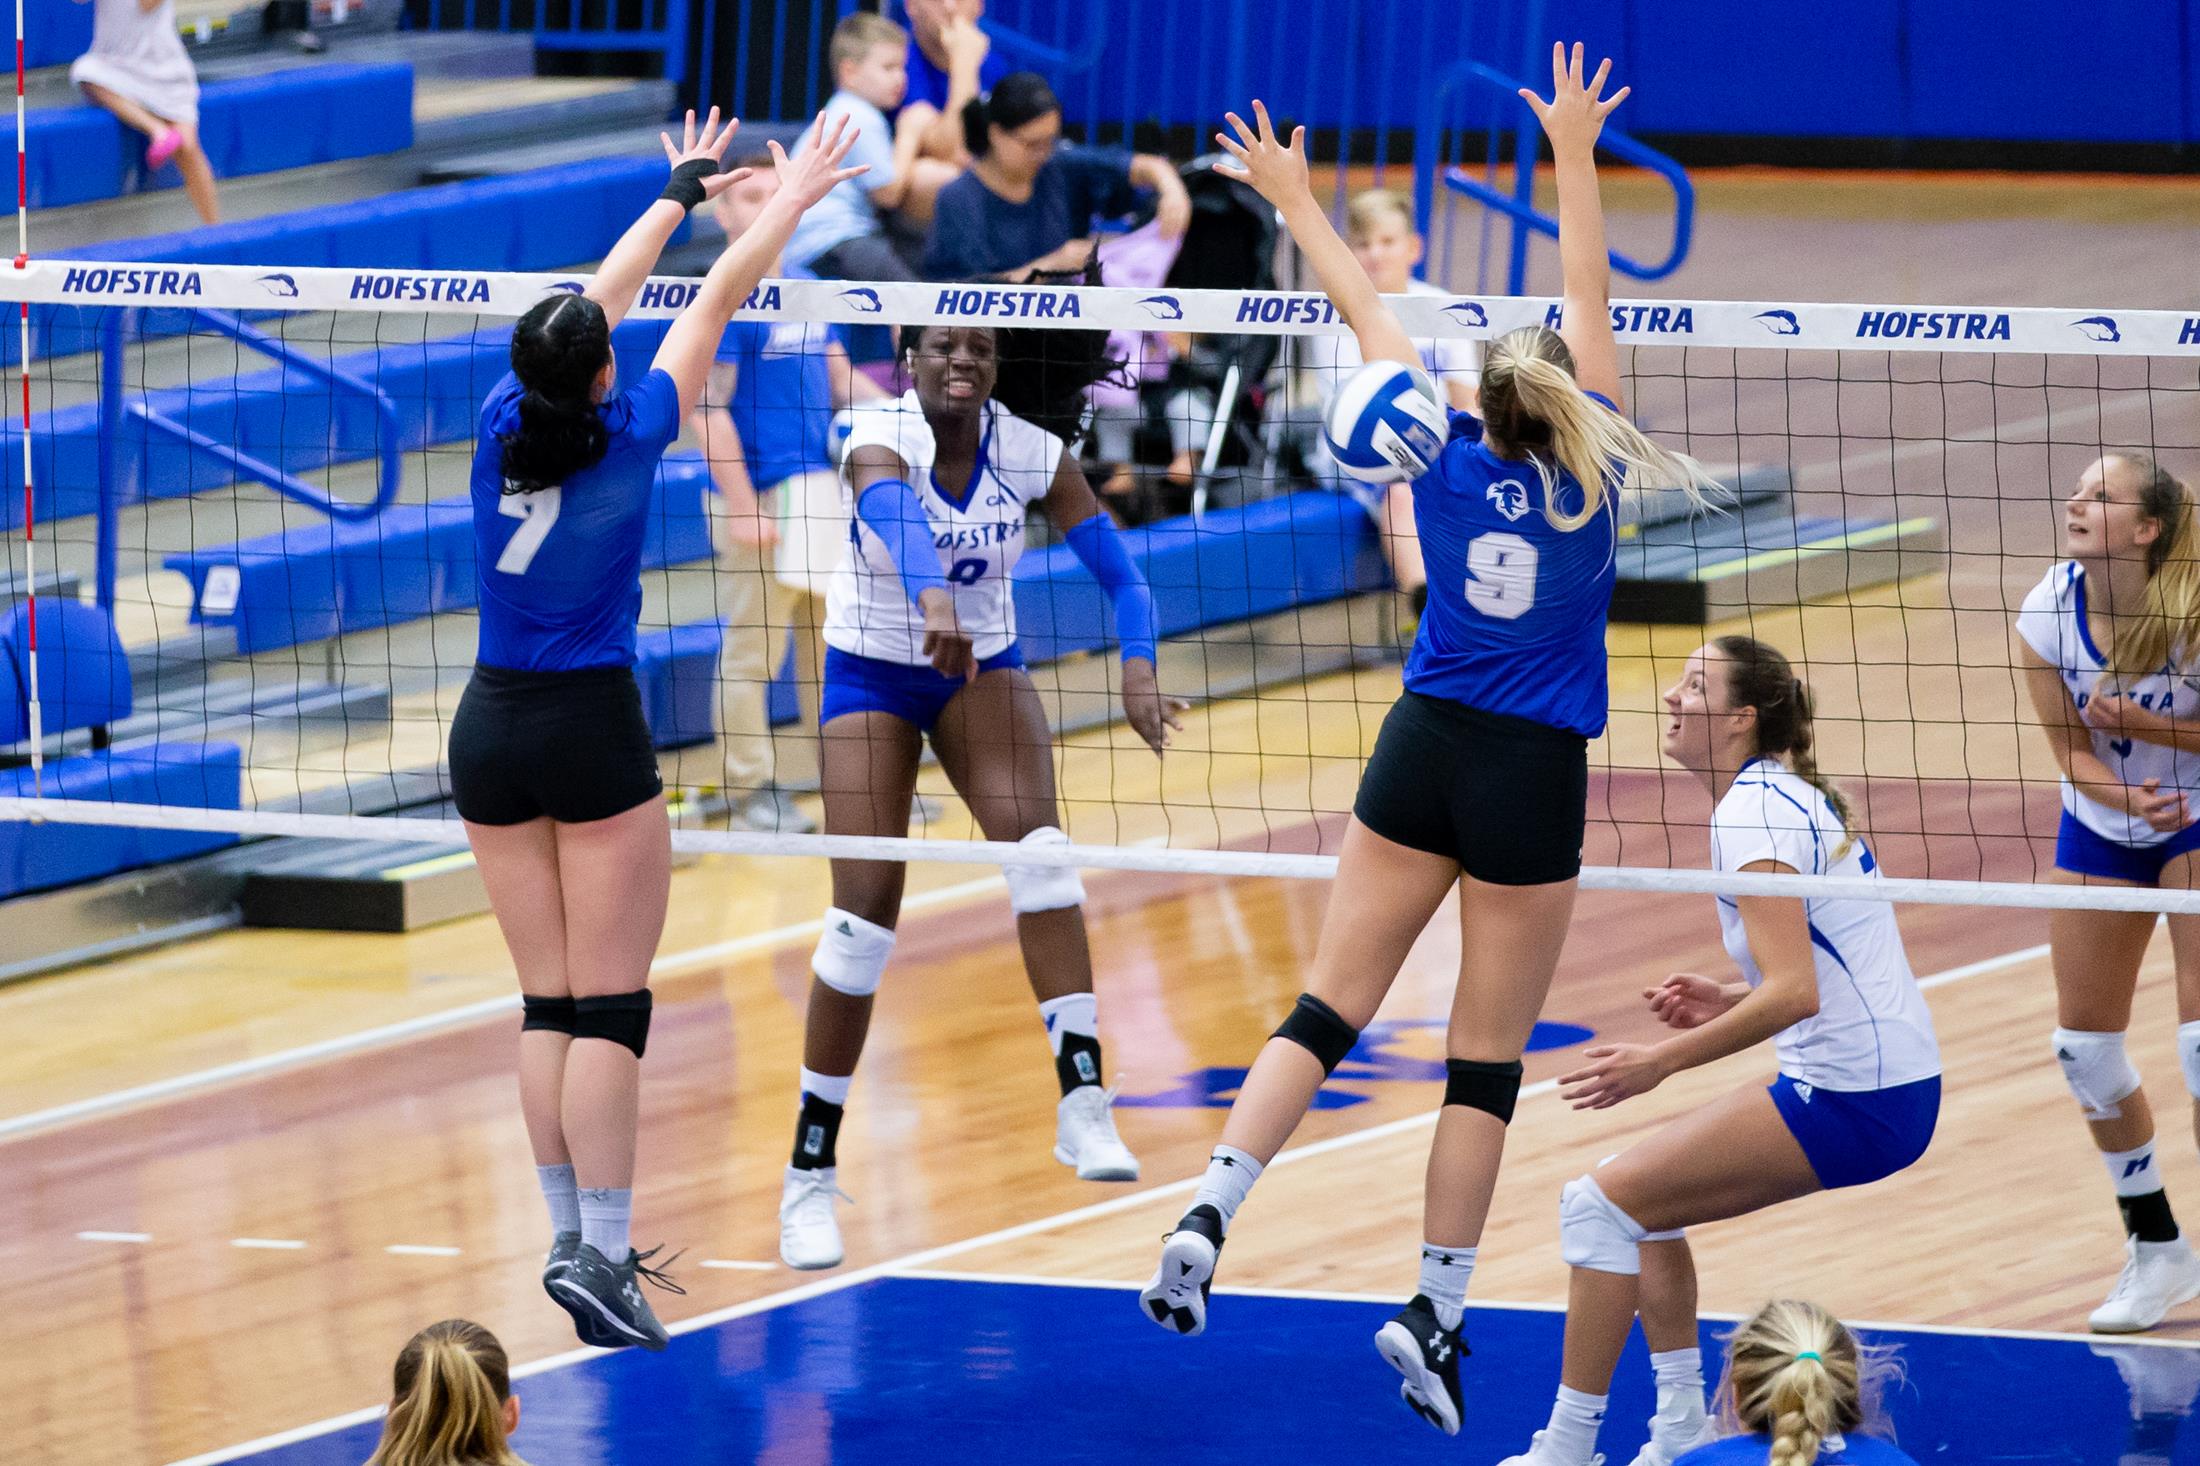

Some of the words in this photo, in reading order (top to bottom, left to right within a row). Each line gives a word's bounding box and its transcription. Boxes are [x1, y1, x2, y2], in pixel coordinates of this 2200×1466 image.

[62, 268, 201, 295] HOFSTRA
[350, 275, 490, 303] HOFSTRA
[639, 283, 781, 310] HOFRA
[935, 289, 1081, 318] HOFSTRA
[1235, 296, 1345, 324] HOFST
[1544, 303, 1694, 333] HSTRA
[1856, 311, 2011, 341] HOFSTRA
[496, 477, 561, 575] 7
[932, 518, 1020, 550] OFSTRA
[1465, 531, 1539, 619] 9
